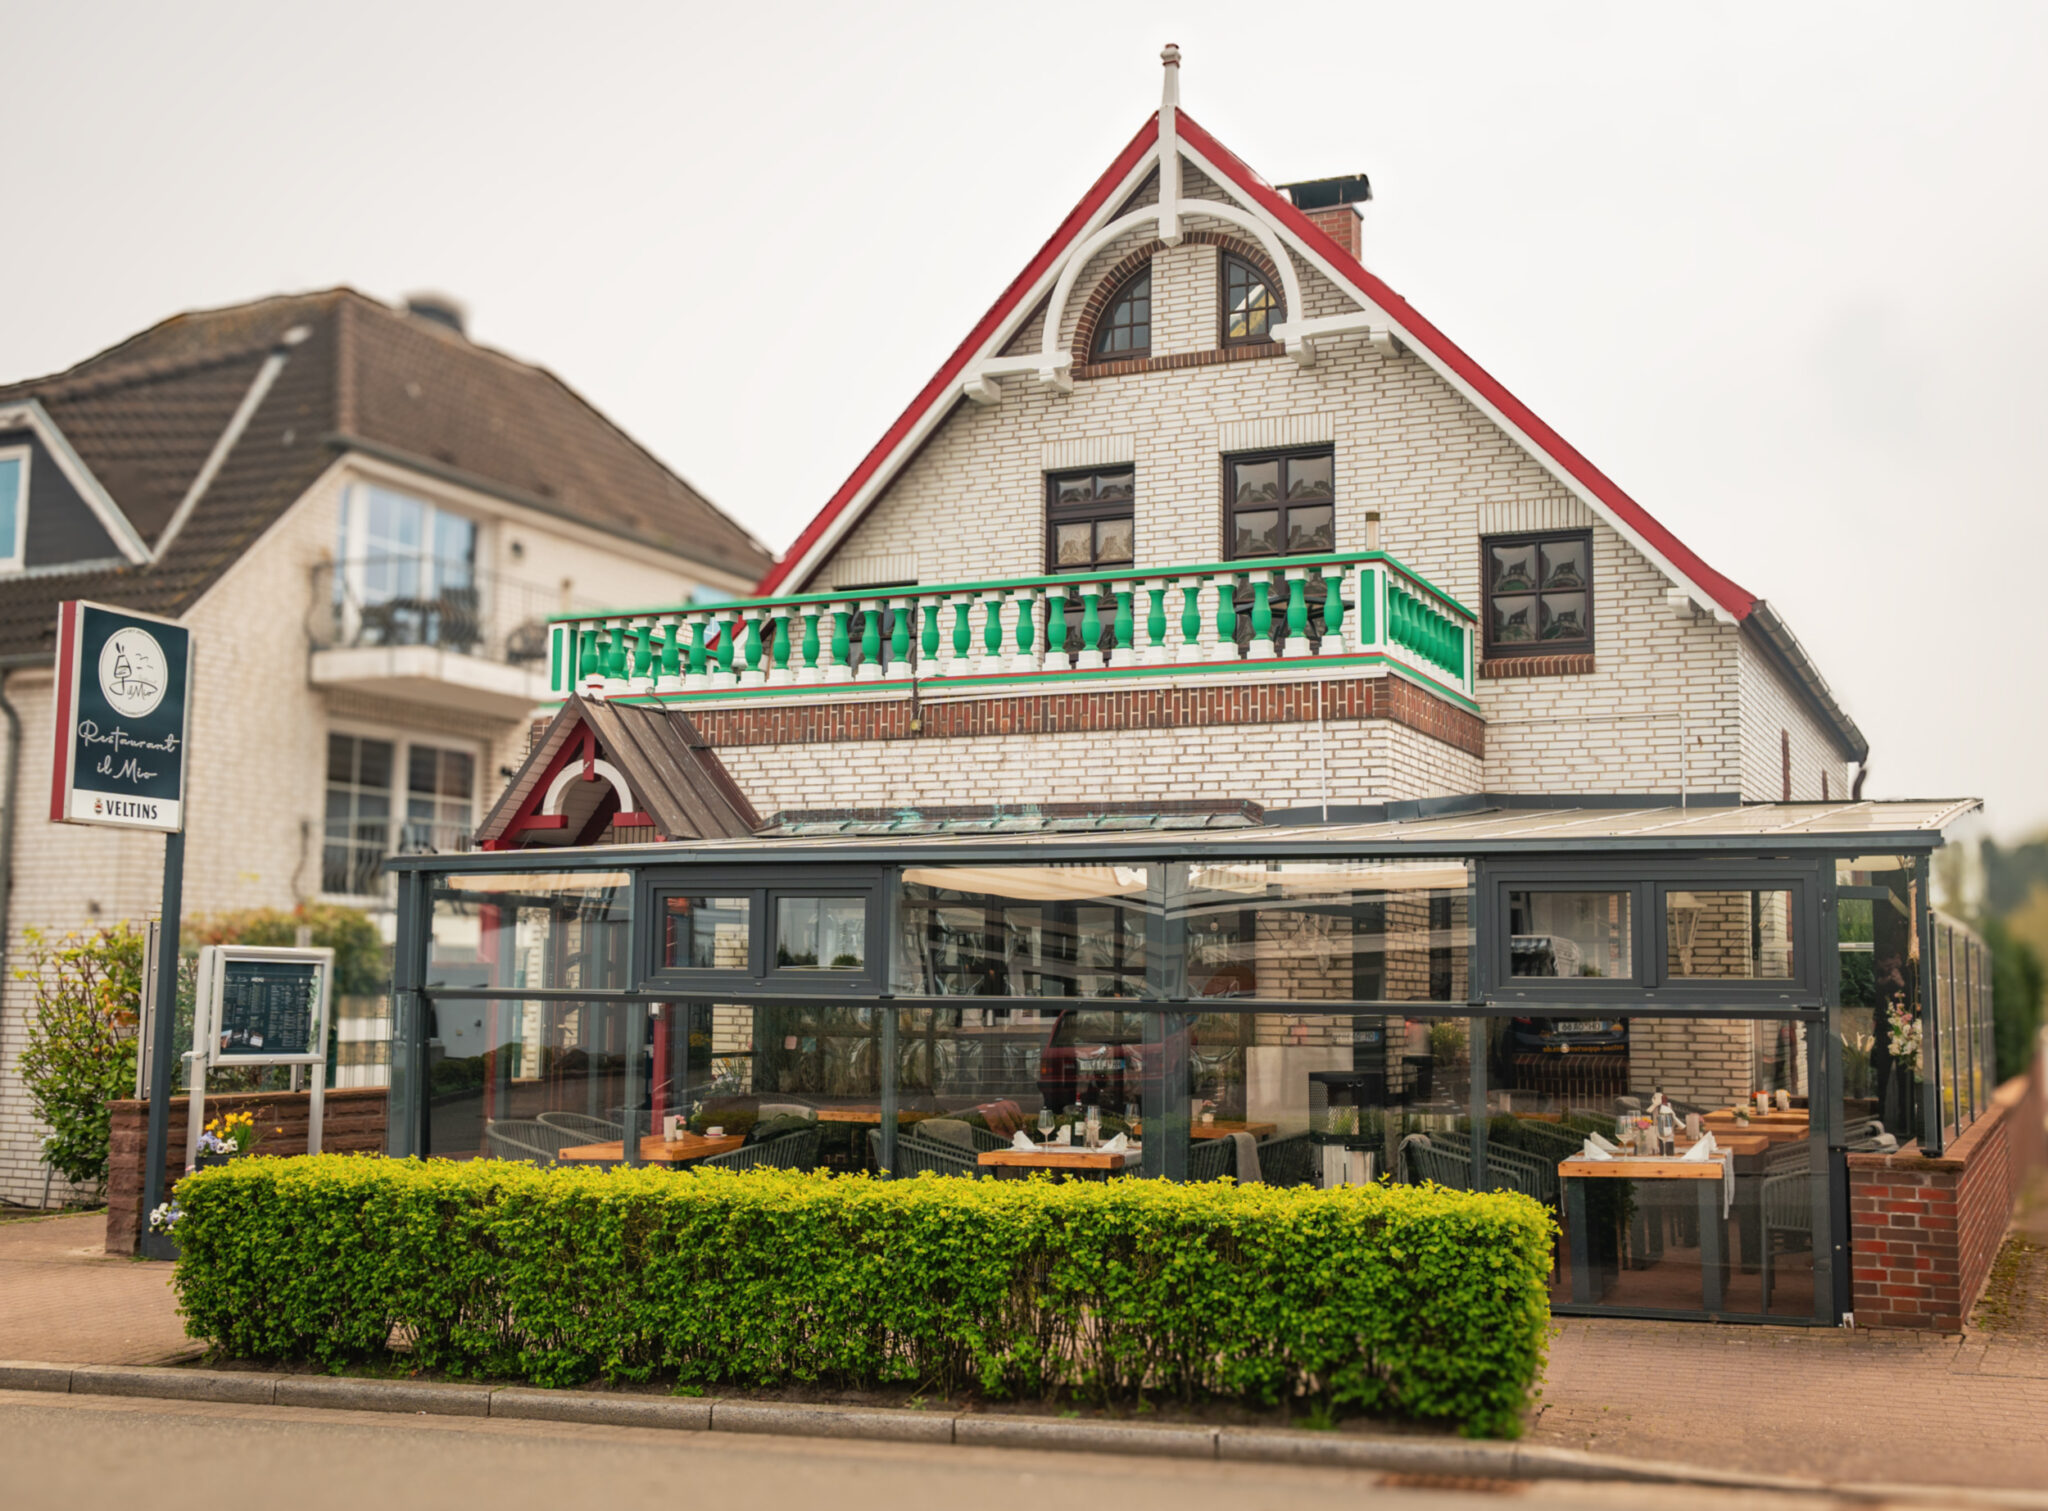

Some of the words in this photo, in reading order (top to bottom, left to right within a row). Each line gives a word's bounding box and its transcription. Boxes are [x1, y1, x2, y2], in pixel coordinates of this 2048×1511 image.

[78, 720, 180, 752] Restaurant
[97, 755, 113, 776] il
[113, 758, 158, 783] Mio
[107, 800, 158, 820] VELTINS
